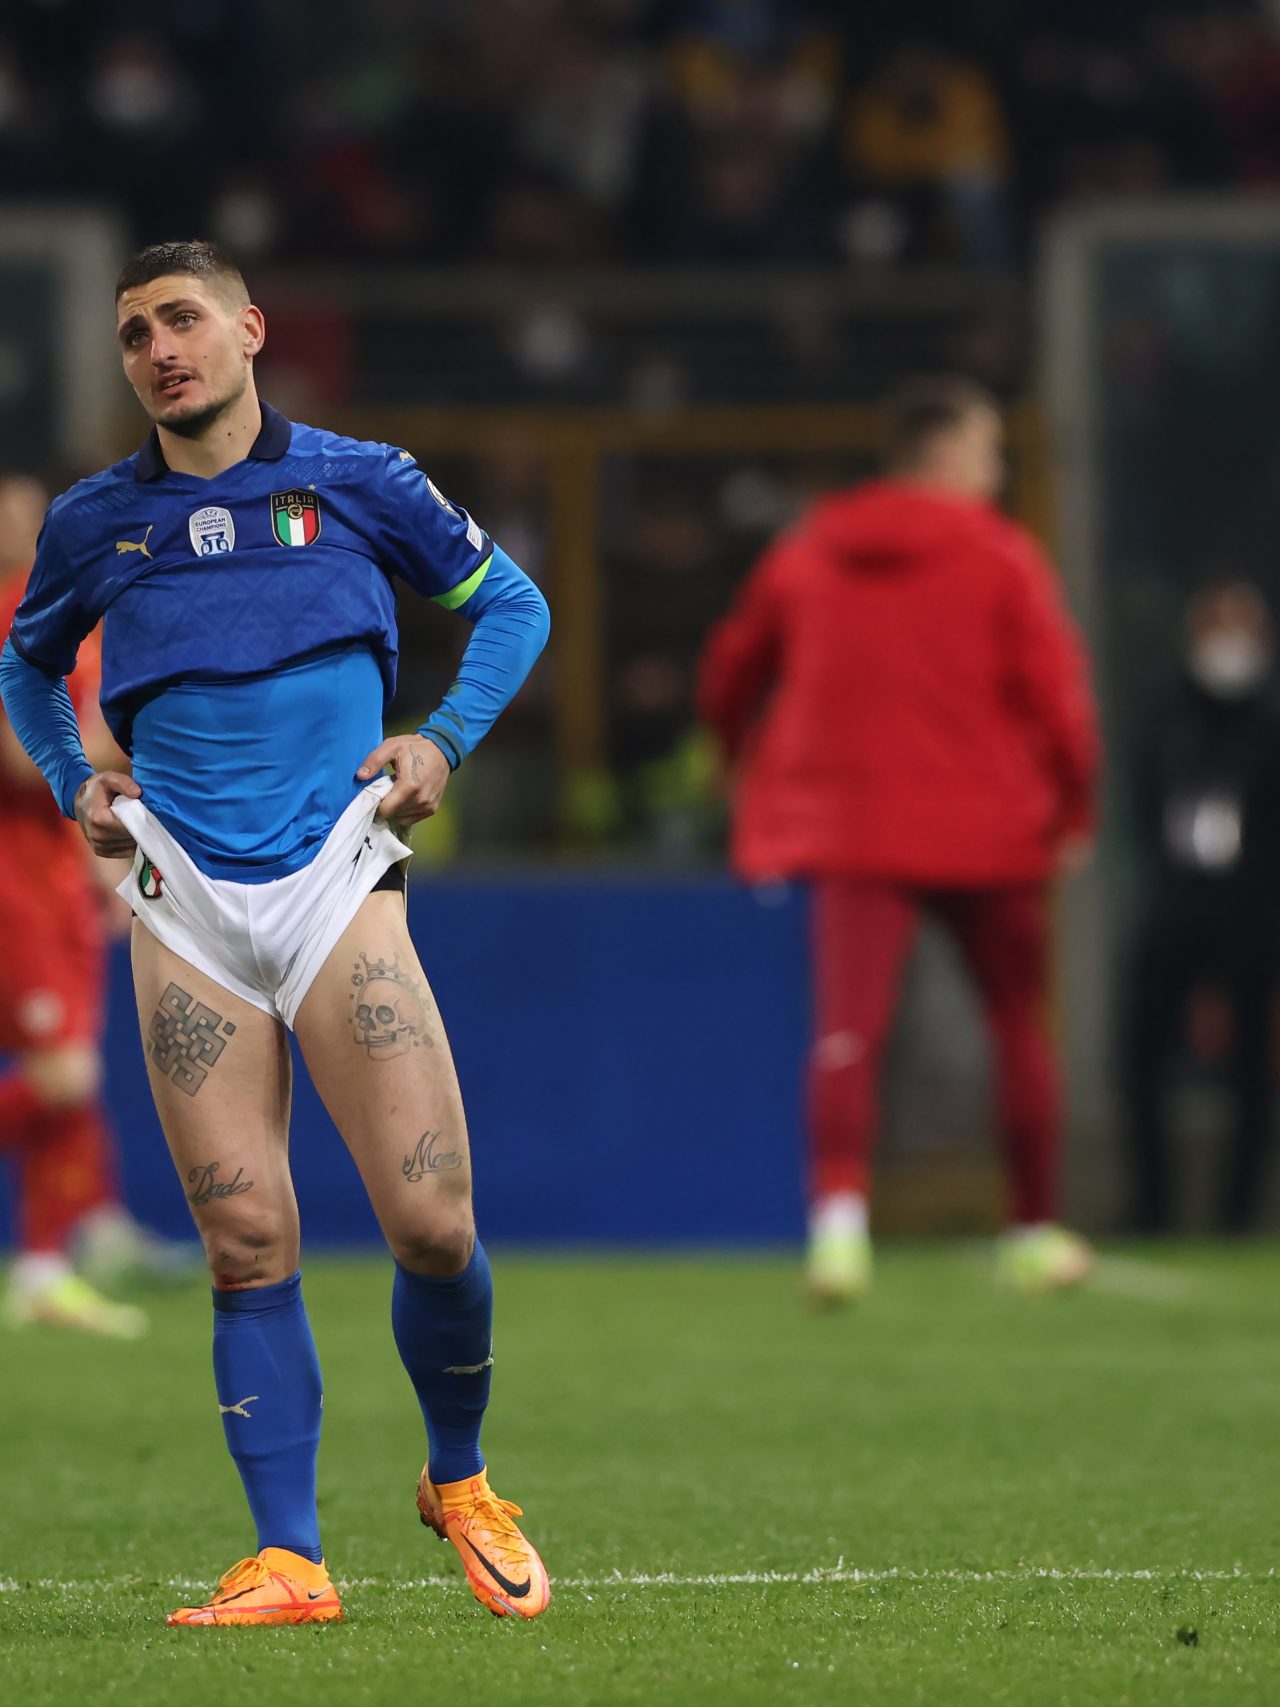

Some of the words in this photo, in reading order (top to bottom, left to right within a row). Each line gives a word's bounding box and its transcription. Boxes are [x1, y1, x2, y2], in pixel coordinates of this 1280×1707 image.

[275, 494, 314, 506] ITALIA
[195, 517, 226, 527] EUROPEAN
[196, 522, 227, 532] CHAMPIONS
[188, 1161, 254, 1206] Dad
